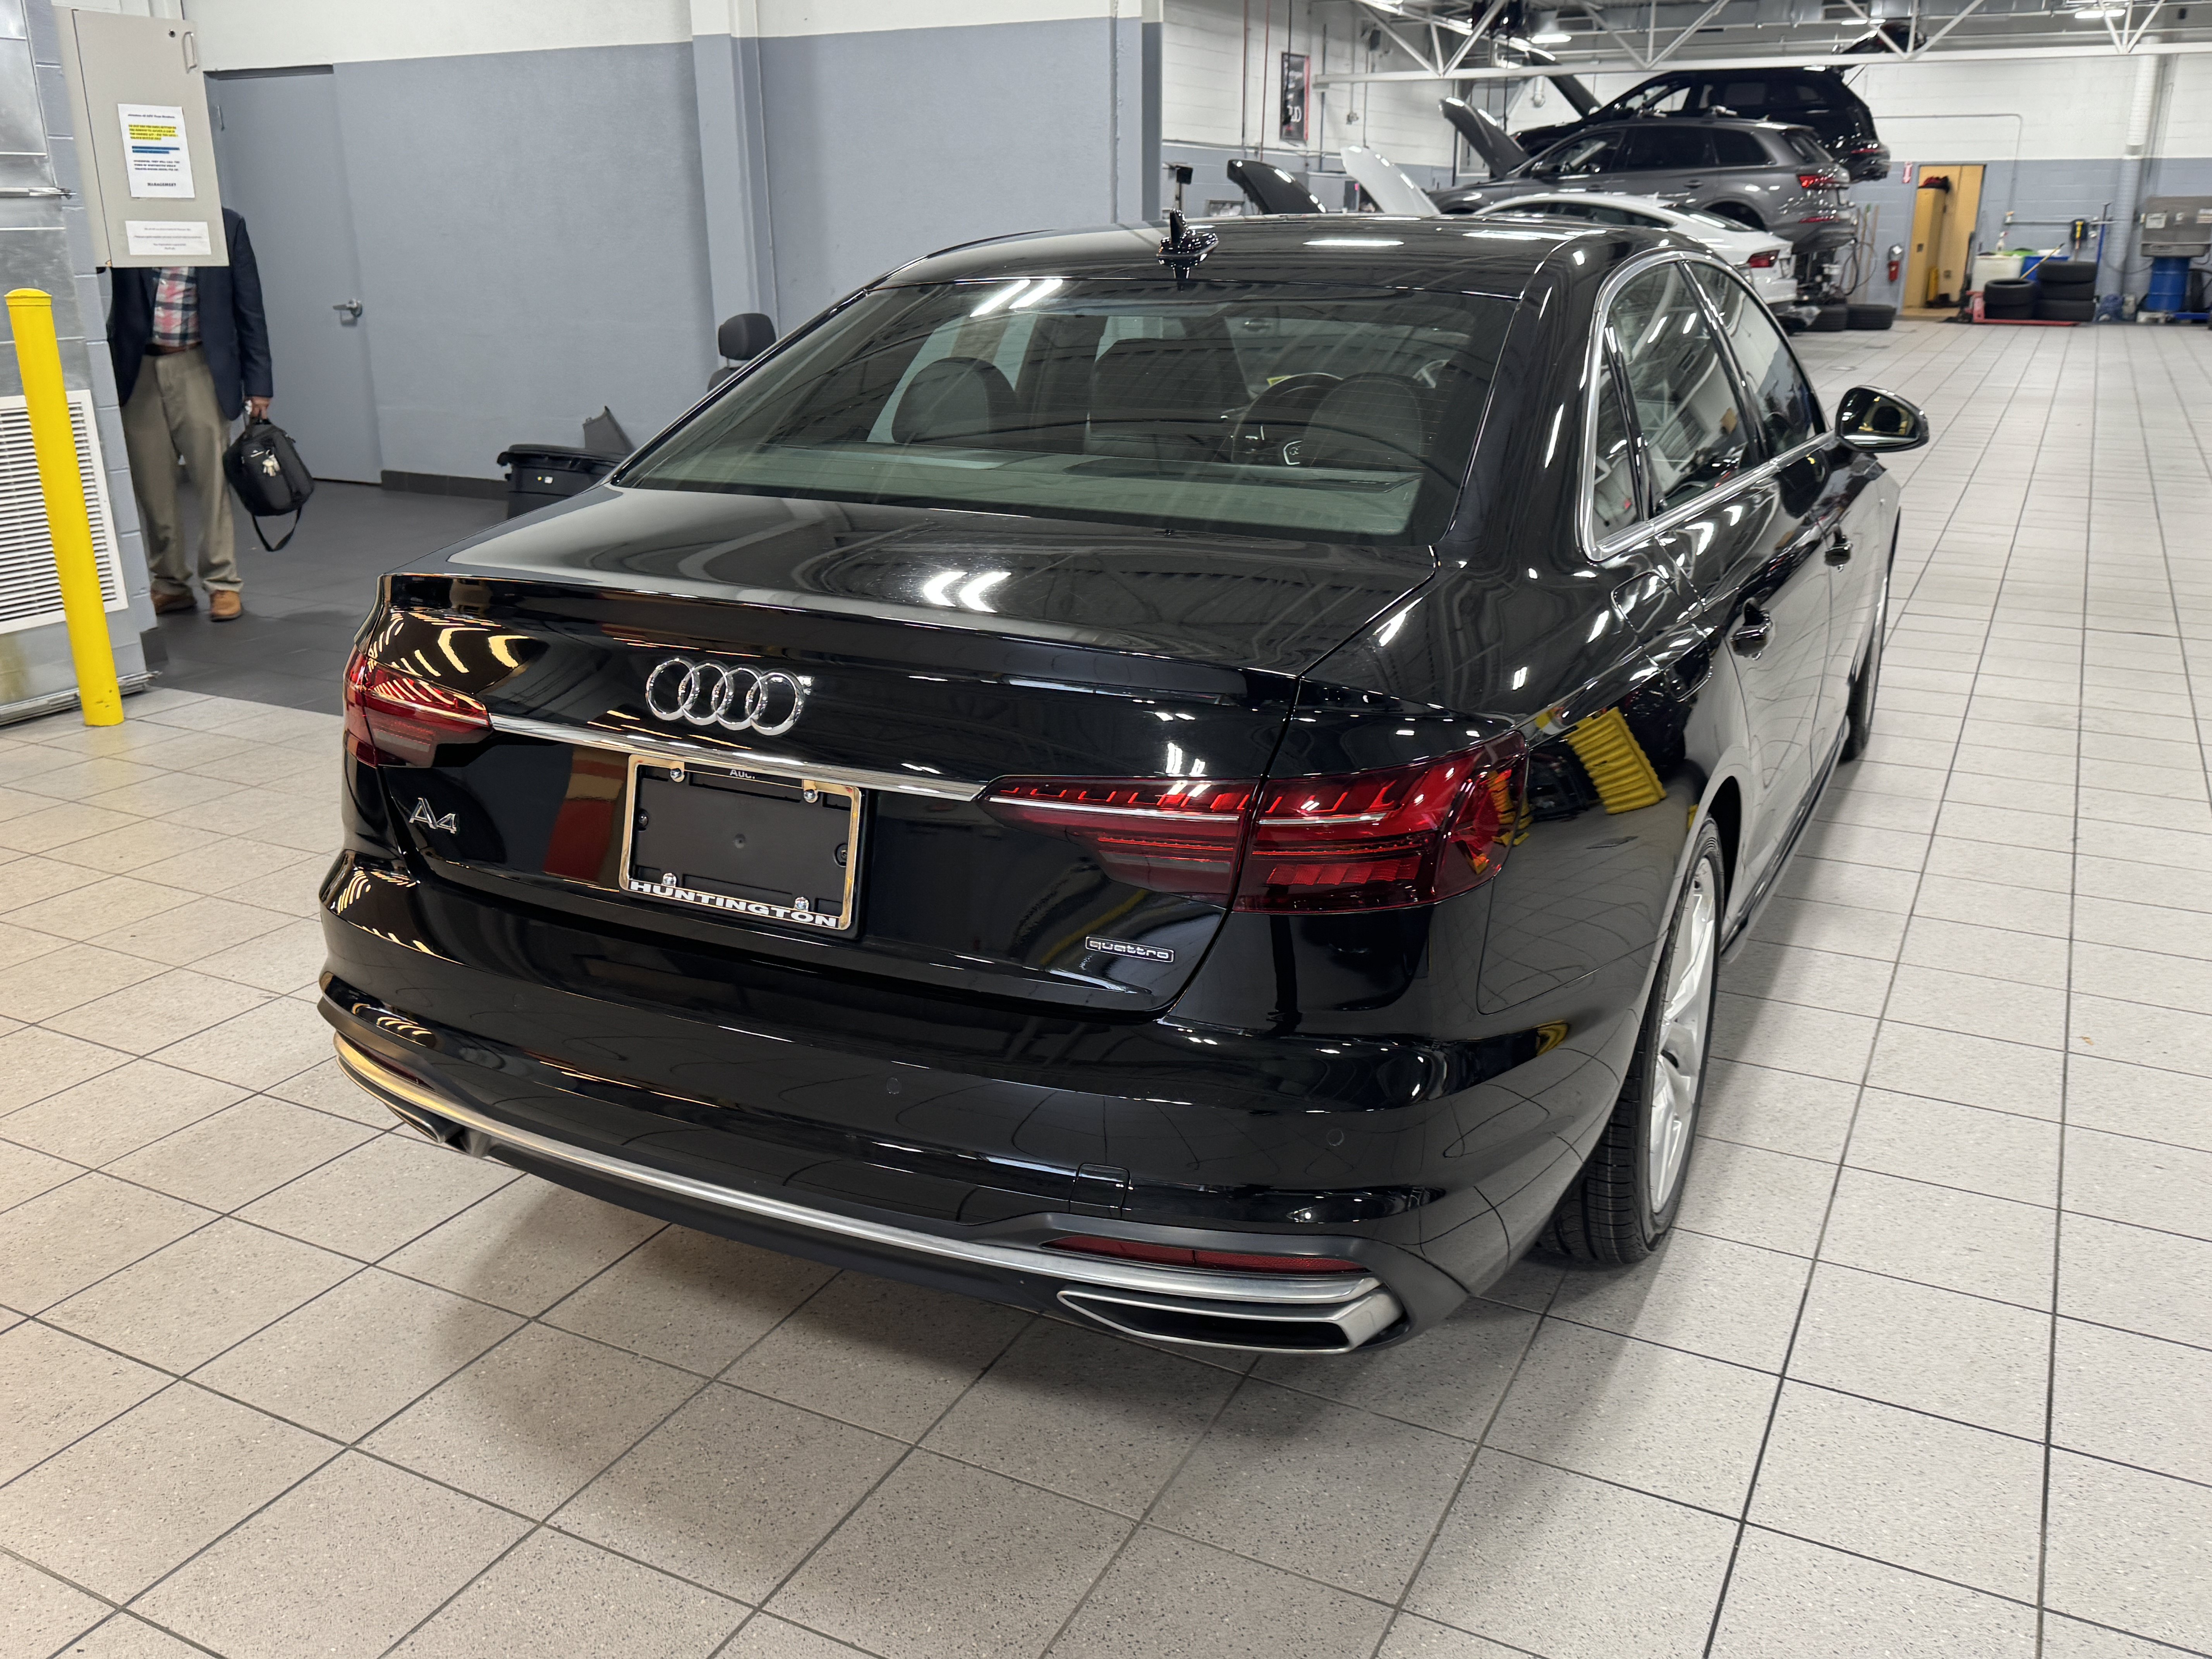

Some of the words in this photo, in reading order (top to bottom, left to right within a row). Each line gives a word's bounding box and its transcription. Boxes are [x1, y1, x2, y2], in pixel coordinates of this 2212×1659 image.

[730, 769, 755, 779] Au
[409, 797, 457, 834] A4
[630, 881, 836, 927] HUNTINGTON
[1089, 941, 1169, 959] quattro
